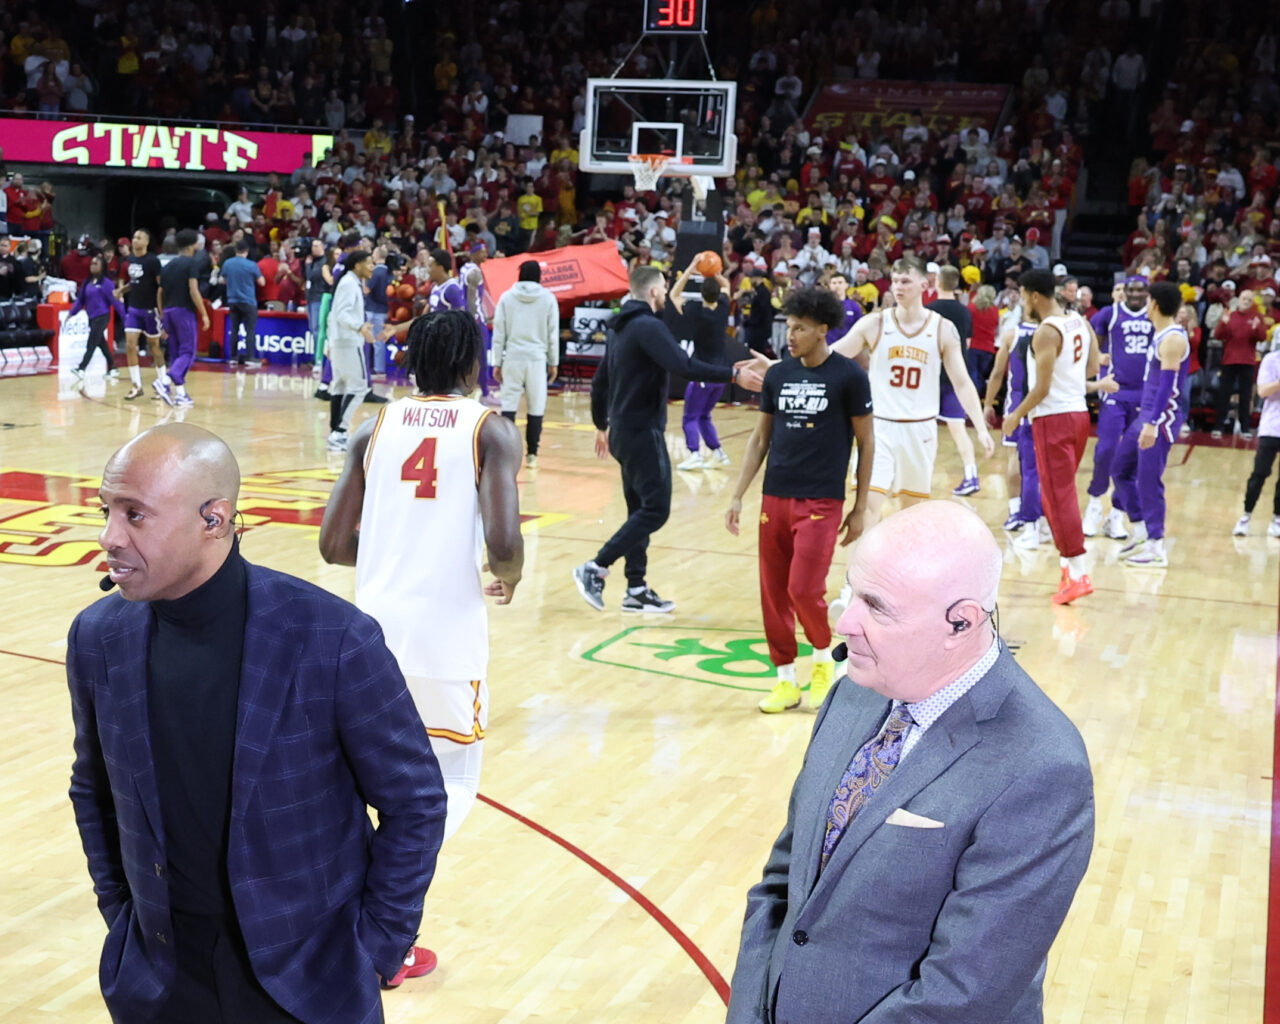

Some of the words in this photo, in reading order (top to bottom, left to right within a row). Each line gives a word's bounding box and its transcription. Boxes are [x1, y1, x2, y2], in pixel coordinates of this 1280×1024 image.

[657, 0, 696, 26] 30
[1121, 320, 1152, 334] TCU
[255, 331, 315, 354] uscell
[1073, 334, 1083, 363] 2
[1125, 335, 1148, 354] 32
[890, 365, 921, 389] 30
[402, 407, 459, 428] WATSON
[401, 437, 438, 500] 4
